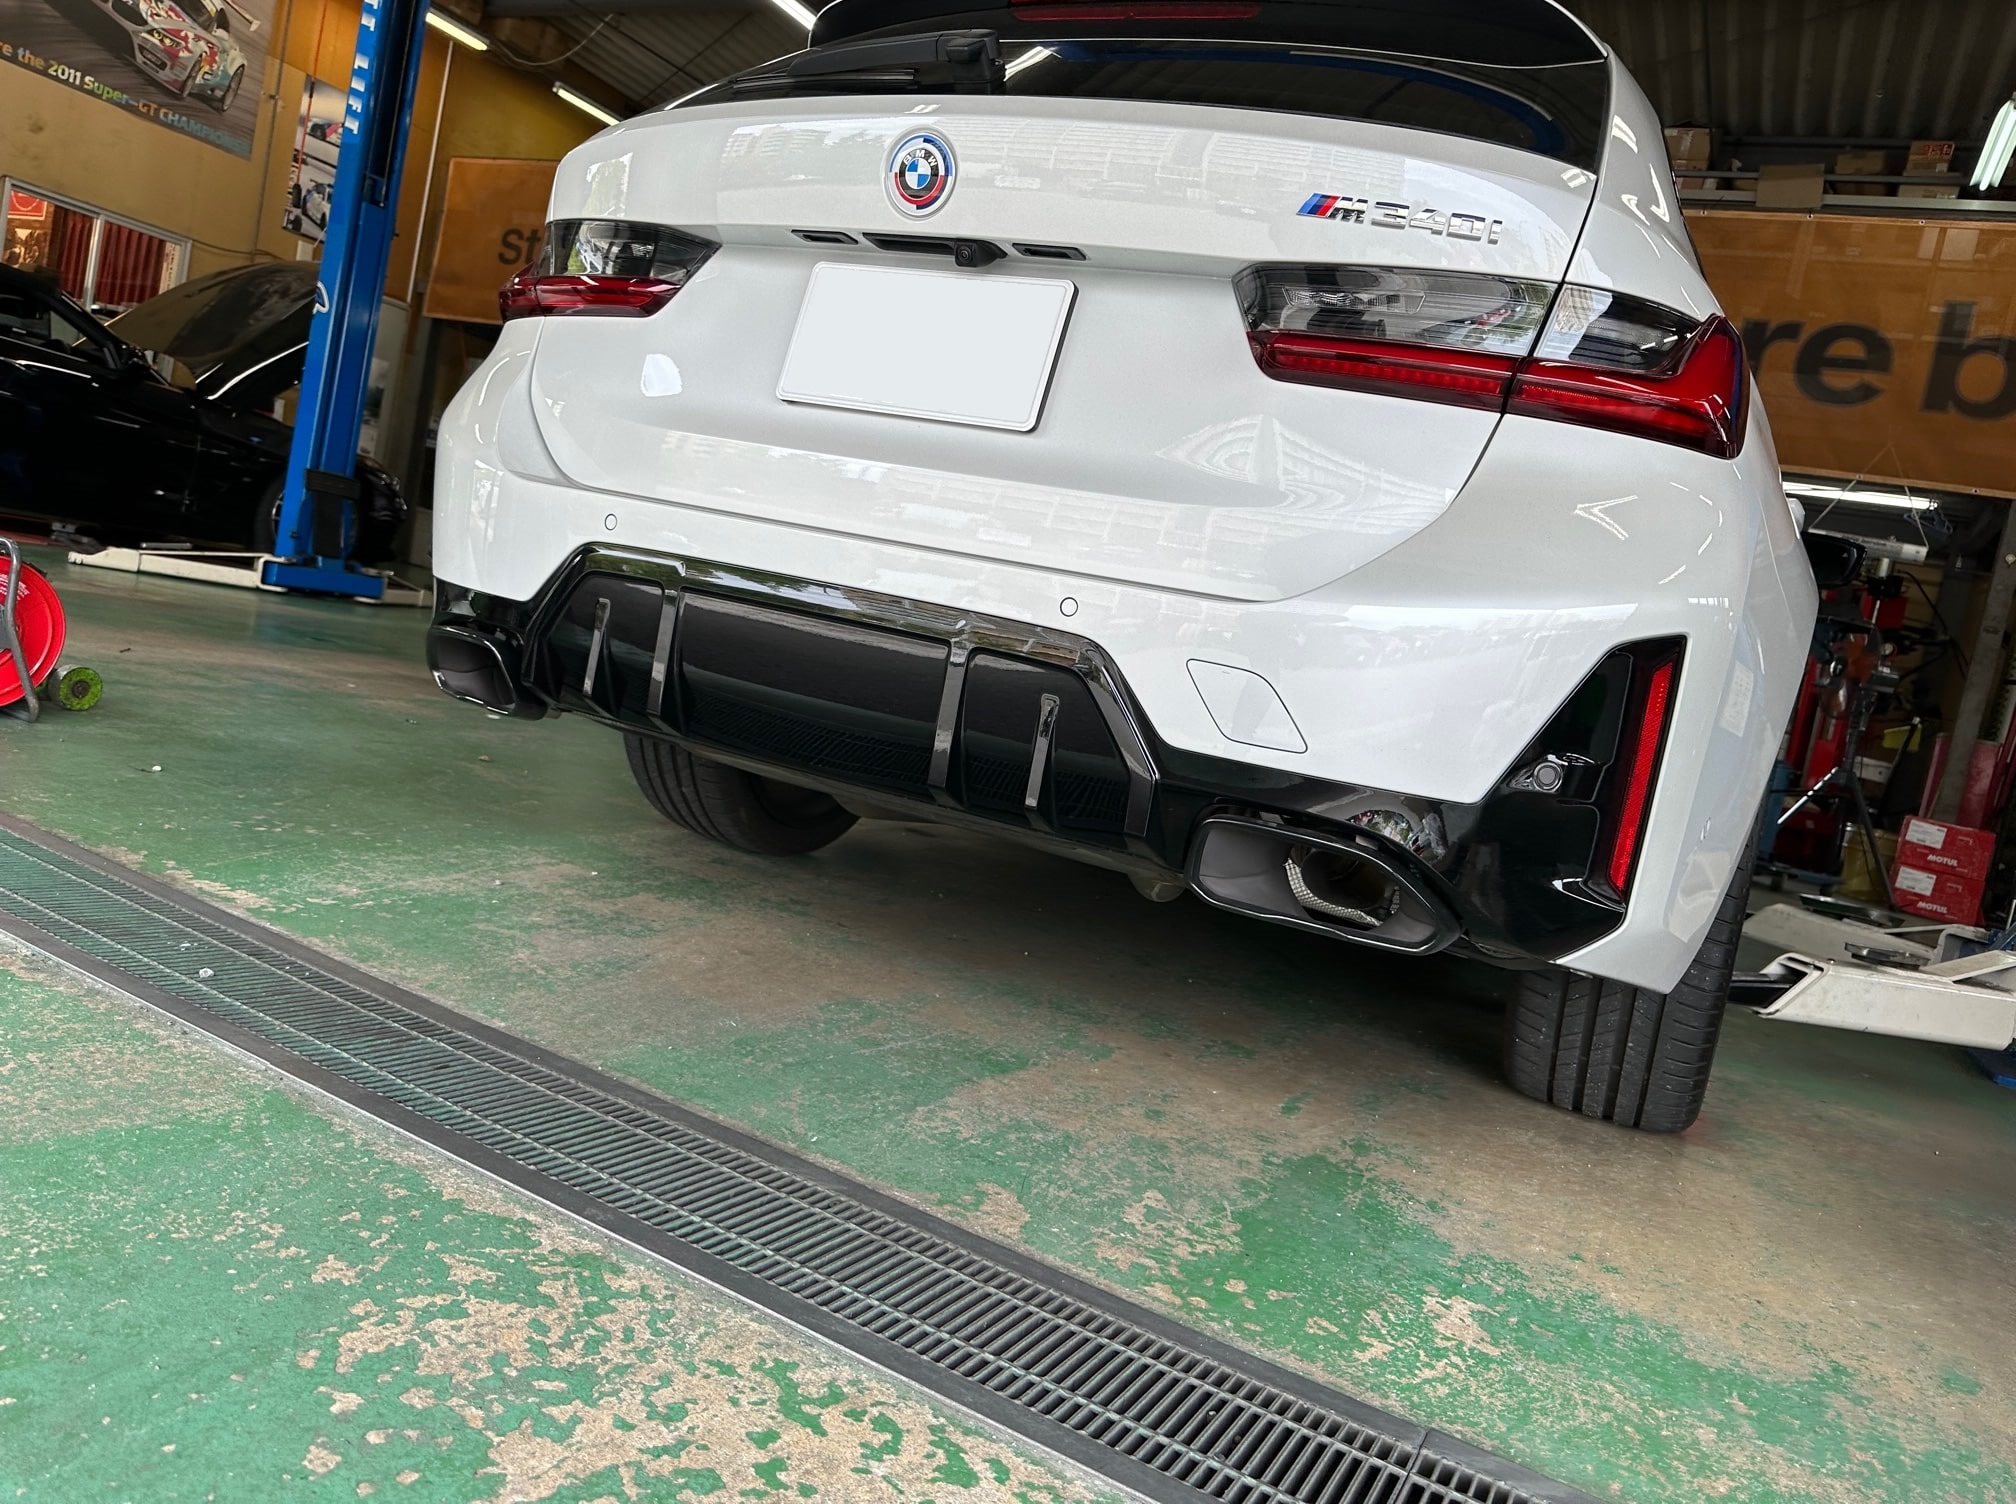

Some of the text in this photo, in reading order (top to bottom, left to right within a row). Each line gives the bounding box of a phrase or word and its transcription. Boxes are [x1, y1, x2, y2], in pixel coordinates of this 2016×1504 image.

[17, 47, 45, 71] the
[48, 60, 81, 86] 2011
[83, 75, 158, 117] Super-GT
[344, 53, 369, 135] LIFT
[903, 149, 938, 167] BMW
[1927, 854, 1958, 867] MOTUL
[1916, 900, 1948, 914] MOTUL
